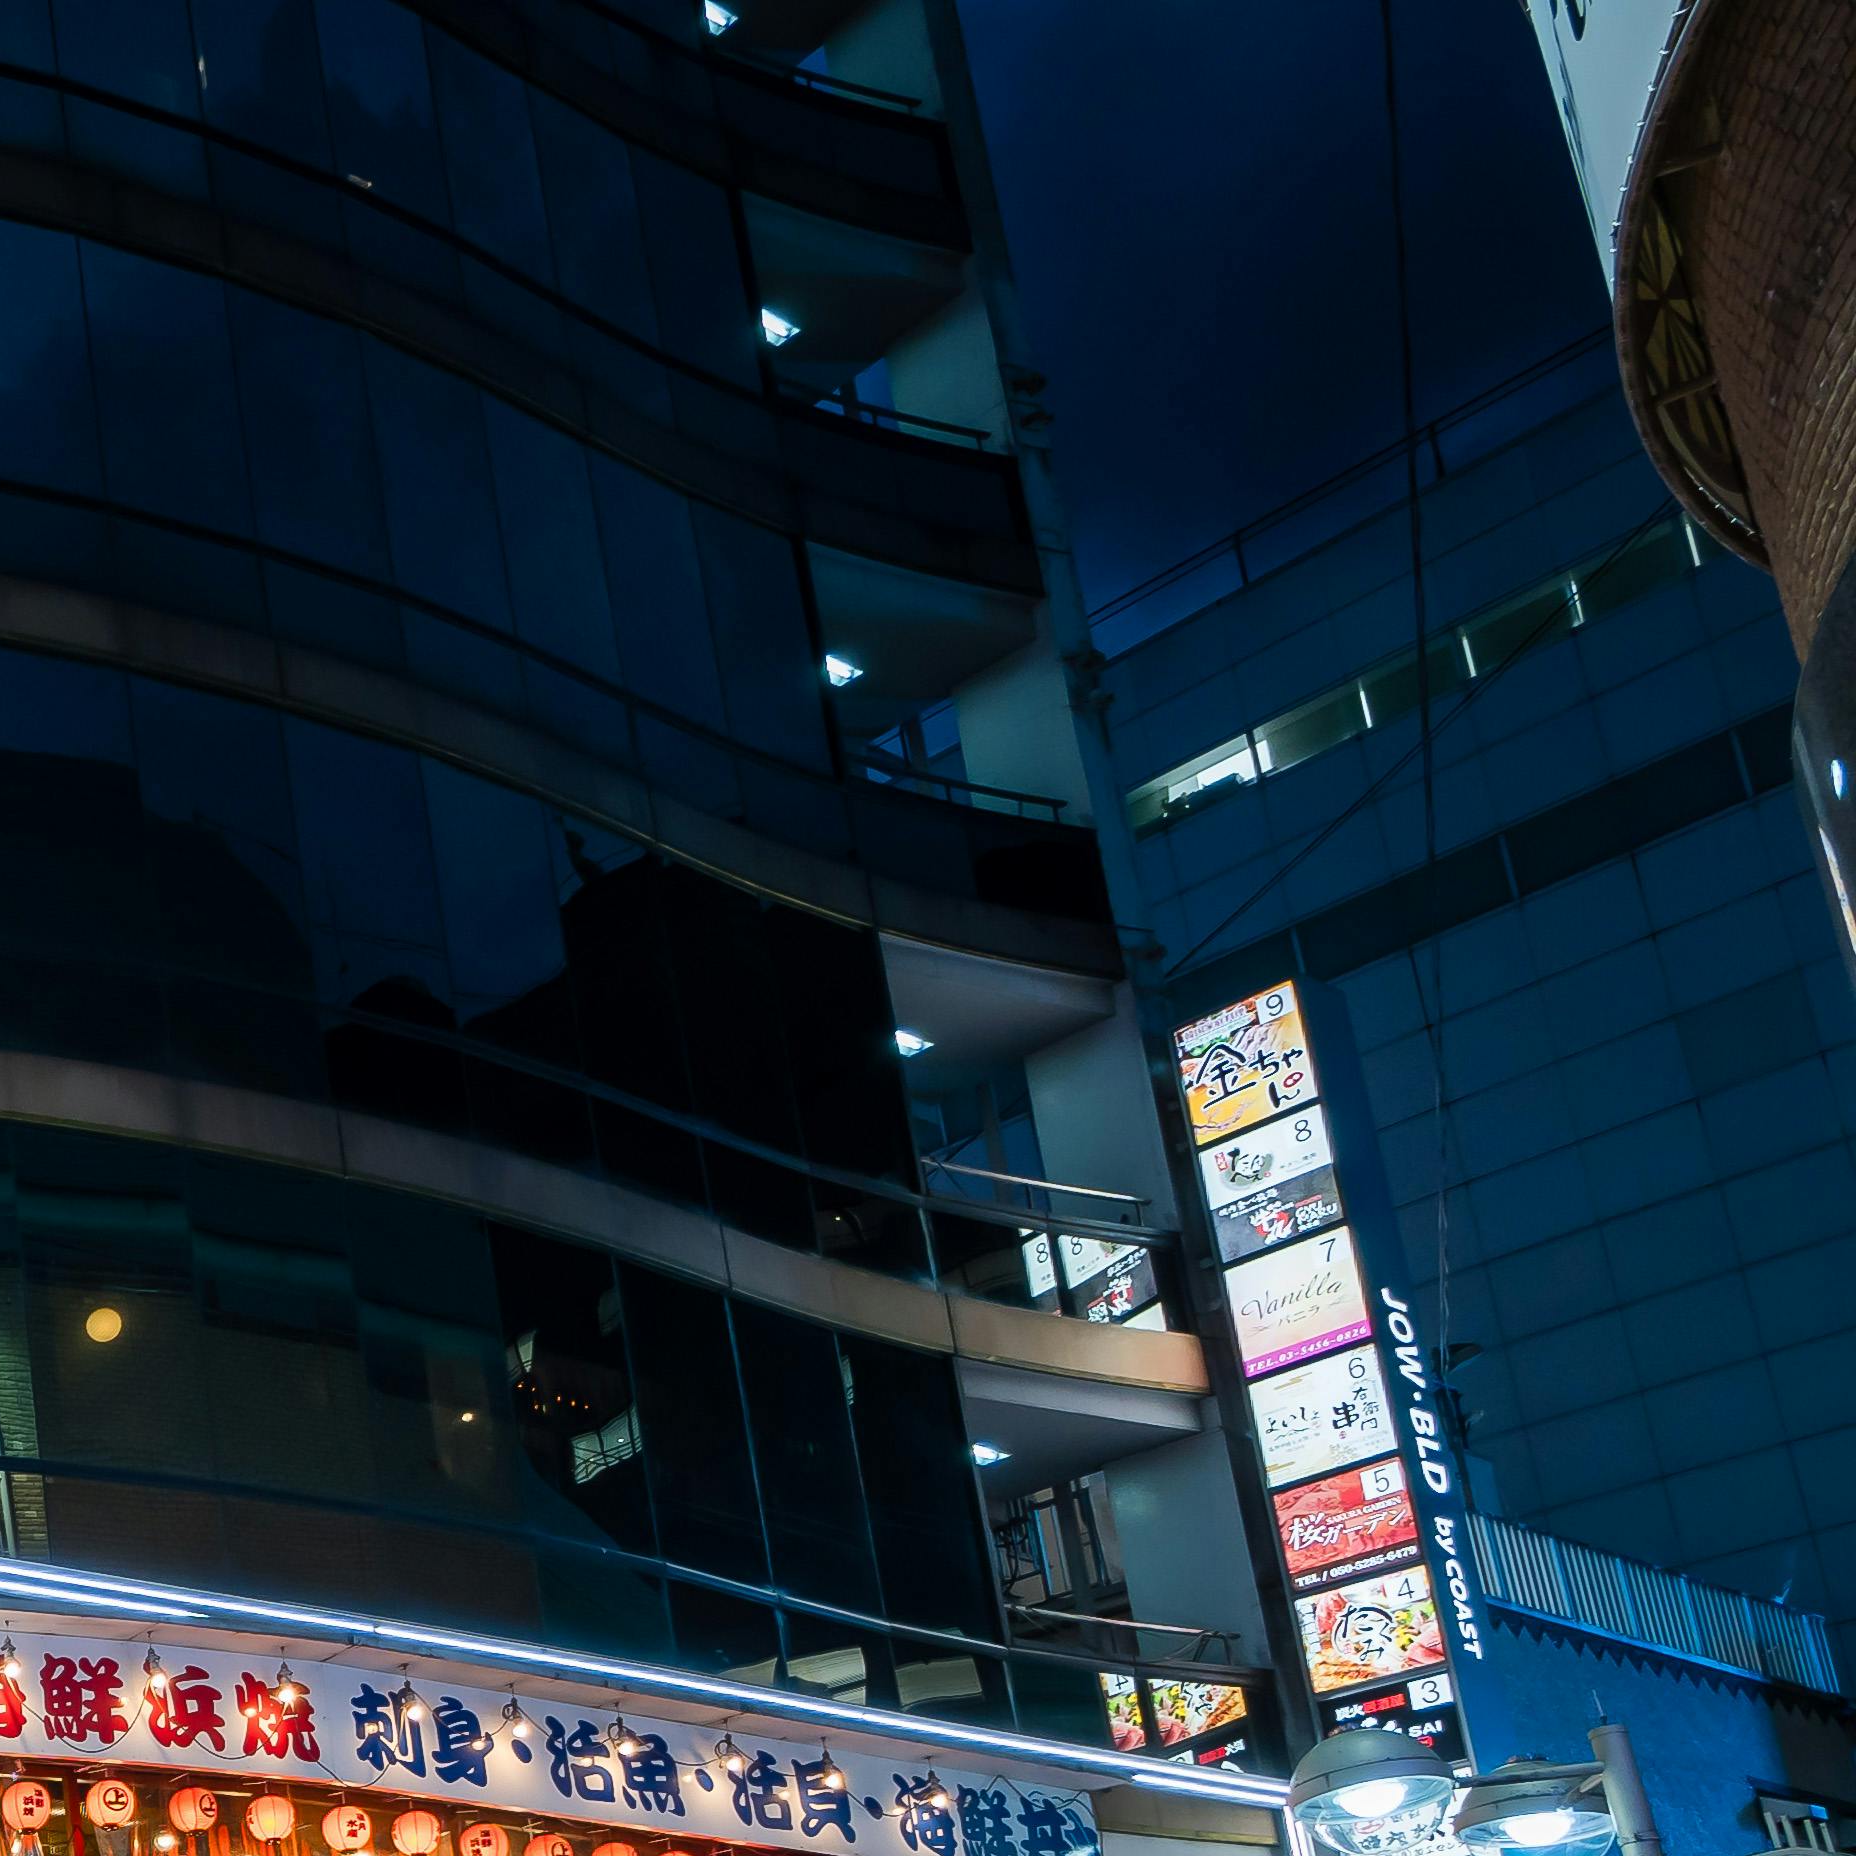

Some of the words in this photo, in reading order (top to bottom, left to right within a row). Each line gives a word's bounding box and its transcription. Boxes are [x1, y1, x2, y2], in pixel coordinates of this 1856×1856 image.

[1266, 993, 1284, 1017] 9
[1195, 1042, 1305, 1111] 金ちゃん
[1294, 1118, 1312, 1142] 8
[1319, 1238, 1337, 1262] 7
[1241, 1272, 1344, 1321] Vanilla
[1277, 1304, 1321, 1327] バニラ
[1247, 1324, 1368, 1375] TEL.03-5456-0826
[1347, 1357, 1366, 1381] 6
[1265, 1405, 1321, 1434] よいしょ
[1352, 1385, 1381, 1432] 右衛門
[1374, 1470, 1390, 1493] 5
[1325, 1507, 1364, 1525] SAKURA
[1364, 1497, 1402, 1515] GARDEN
[1288, 1507, 1409, 1551] 桜ガーデン
[1433, 1517, 1457, 1555] by
[1295, 1574, 1321, 1588] TEL
[1398, 1577, 1413, 1601] 4
[1443, 1556, 1485, 1661] COAST
[1339, 1606, 1394, 1661] たくみ
[1421, 1680, 1441, 1704] 3
[1408, 1719, 1444, 1737] SAI
